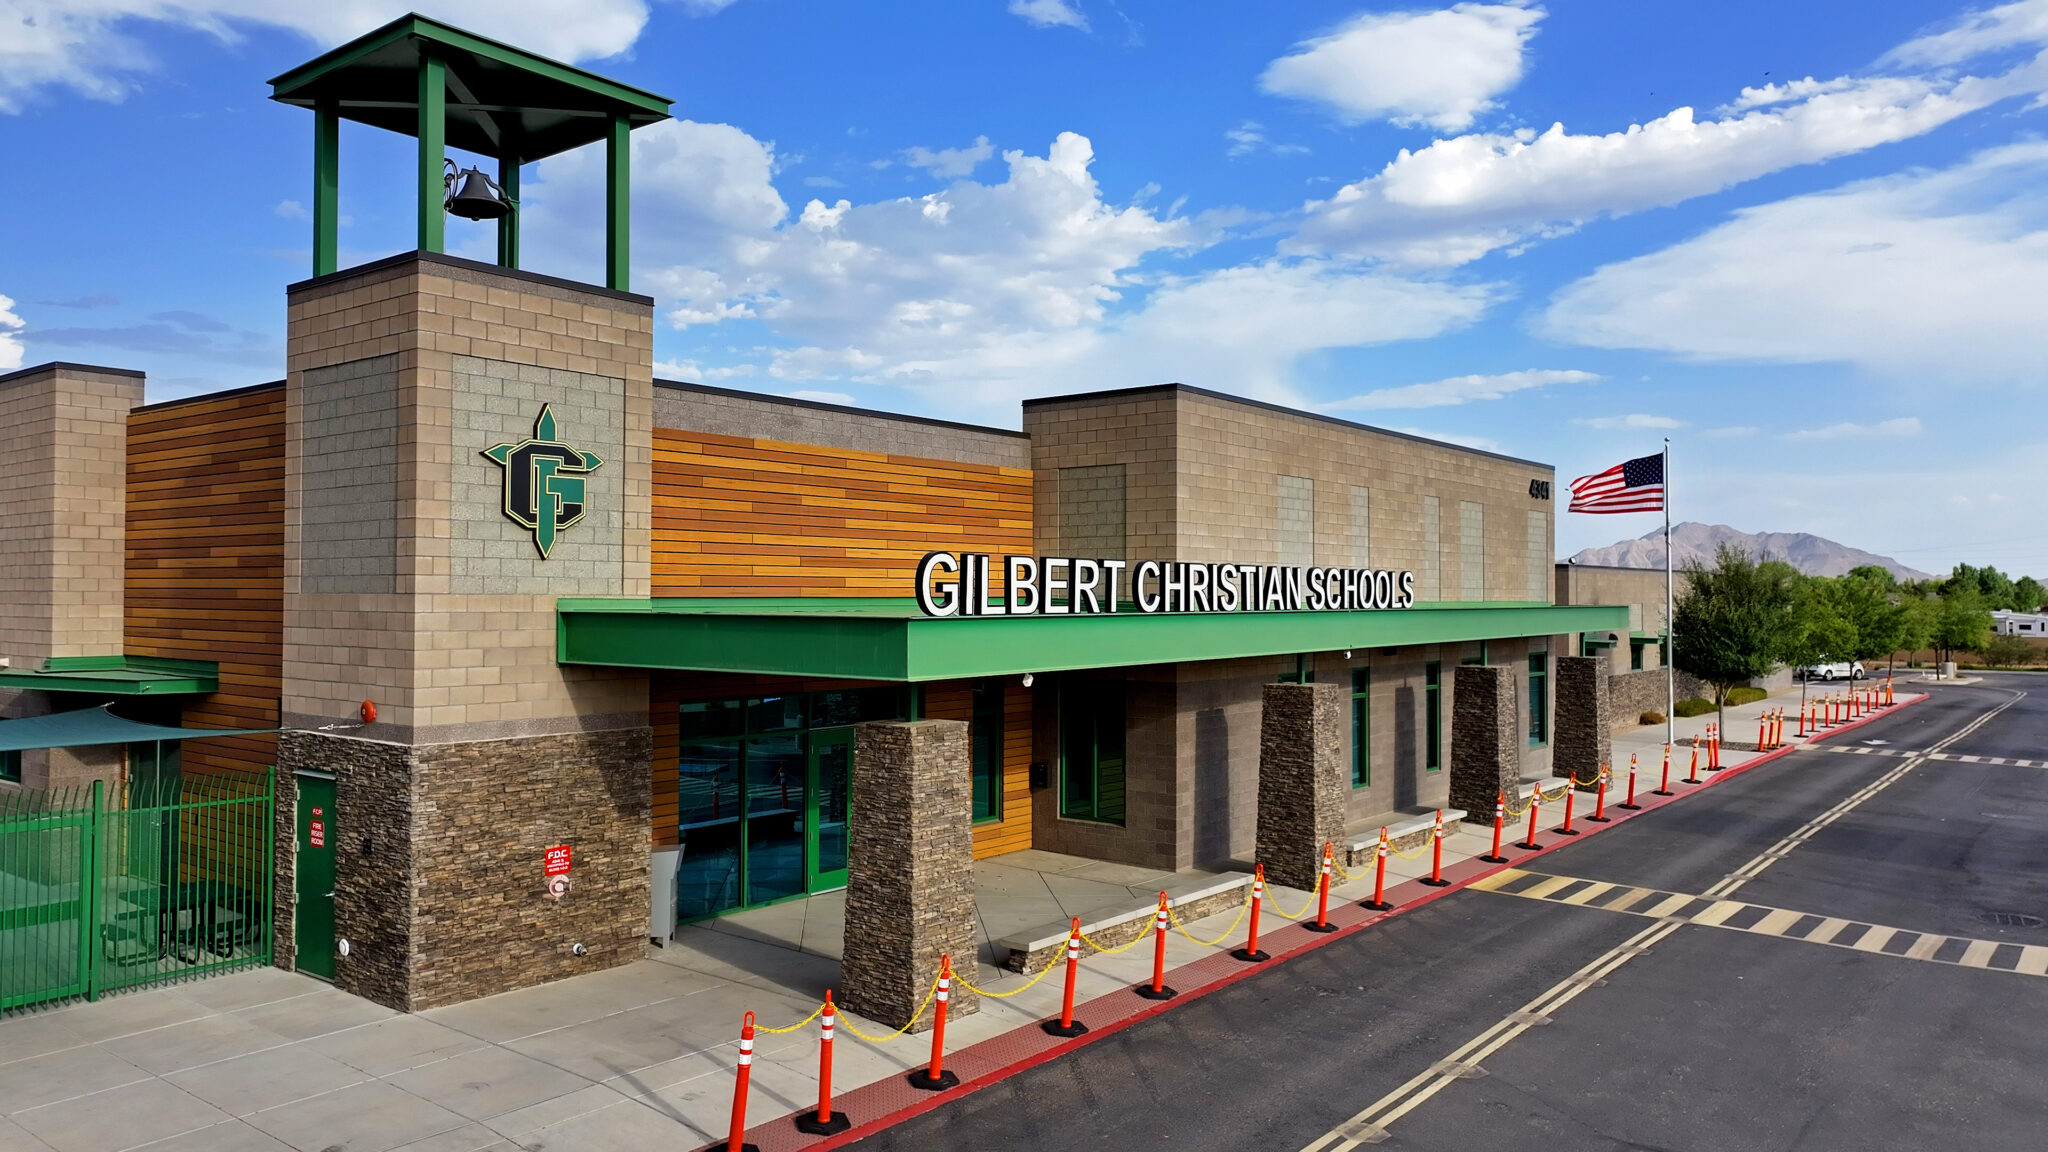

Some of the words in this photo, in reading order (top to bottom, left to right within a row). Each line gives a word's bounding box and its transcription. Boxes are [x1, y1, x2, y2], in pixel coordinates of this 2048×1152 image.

[915, 551, 1126, 617] GILBERT
[1132, 561, 1301, 613] CHRISTIAN
[1305, 567, 1415, 610] SCHOOLS
[312, 822, 322, 830] FIRE
